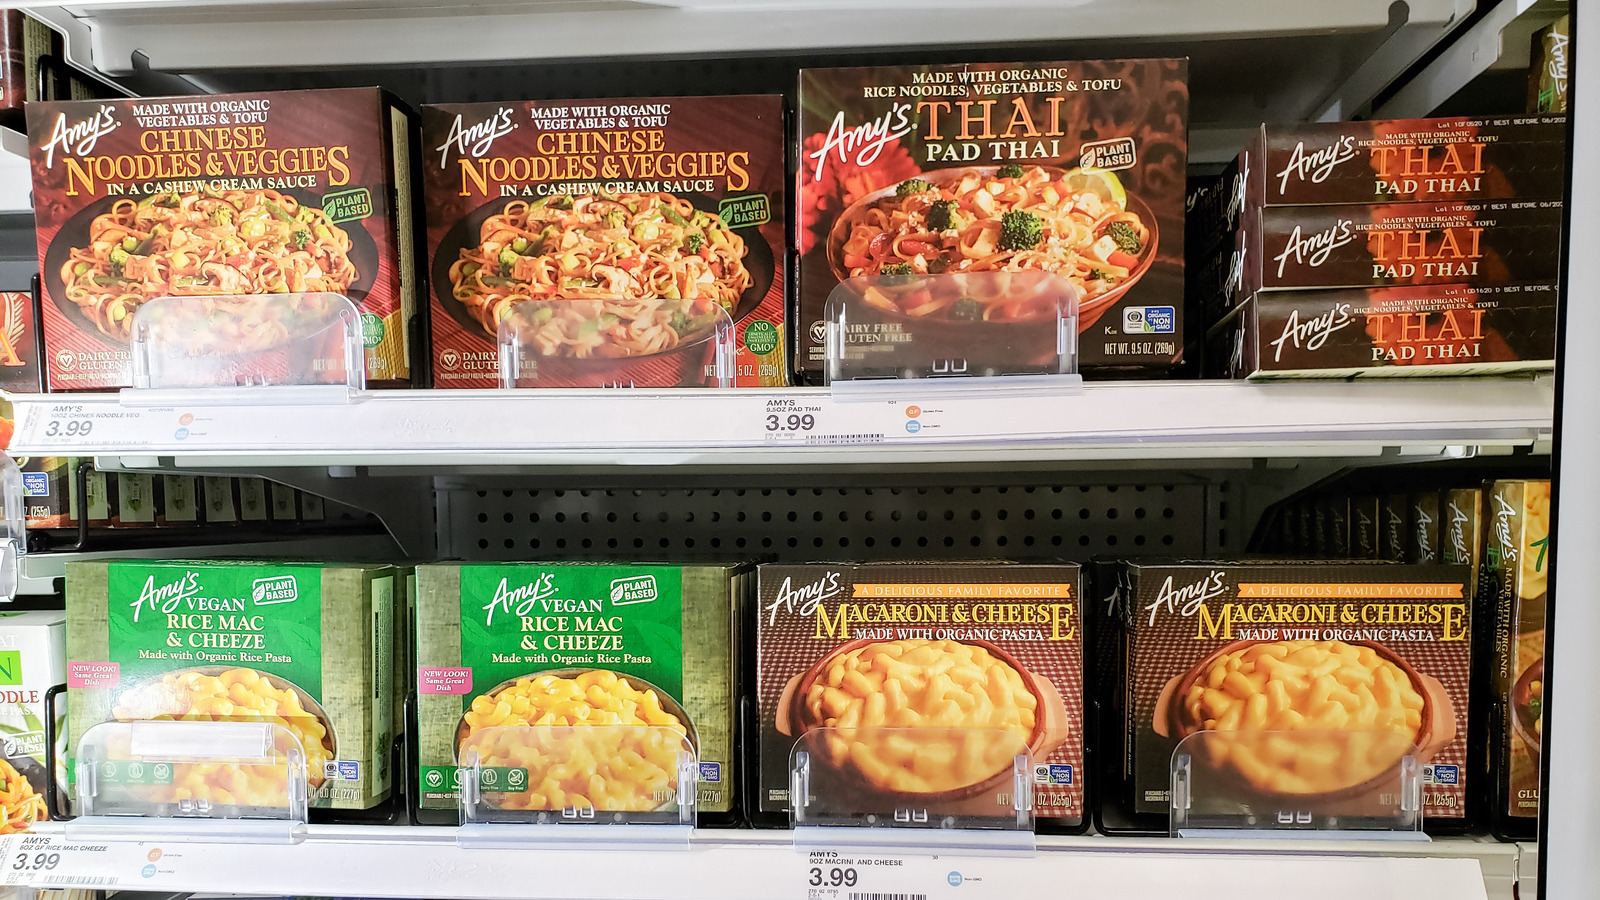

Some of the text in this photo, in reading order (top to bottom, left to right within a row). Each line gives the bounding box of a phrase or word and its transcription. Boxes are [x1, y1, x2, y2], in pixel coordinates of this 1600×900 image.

[913, 68, 1068, 84] MADE WITH ORGANIC
[864, 79, 1121, 98] RICE NOODLES, VEGETABLES & TOFU
[133, 100, 270, 116] MADE WITH ORGANIC
[531, 104, 671, 119] MADE WITH ORGANIC
[136, 111, 267, 127] VEGETABLES & TOFU
[534, 116, 668, 130] VEGETABLES & TOFU
[917, 97, 1065, 140] THAI
[140, 126, 267, 153] CHINESE
[537, 130, 665, 155] CHINESE
[926, 140, 1060, 162] PAD THAI
[1096, 142, 1130, 156] PLANT
[1097, 154, 1132, 168] BASED
[1371, 144, 1487, 177] THAI
[63, 146, 351, 196] NOODLES & VEGGIES
[458, 151, 750, 197] NOODLES & VEGGIES
[107, 175, 317, 195] IN A CASHEW CREAM SAUCE
[500, 179, 714, 197] IN A CASHEW CREAM SAUCE
[1375, 178, 1481, 194] PAD THAI
[337, 193, 366, 206] PLANT
[734, 199, 764, 212] PLANT
[337, 204, 369, 217] BASED
[734, 210, 766, 223] BASED
[1368, 228, 1484, 261] THAI
[1372, 262, 1478, 278] PAD THAI
[754, 323, 769, 332] NO
[1366, 310, 1486, 344] THAI
[1105, 342, 1117, 355] NET
[1118, 342, 1130, 355] WT.
[1131, 342, 1142, 354] 9.5
[1154, 341, 1175, 355] (269g)
[1371, 344, 1481, 360] PAD THAI
[45, 421, 93, 436] 3.99
[766, 414, 814, 430] 3.99
[266, 580, 293, 591] PLANT
[624, 580, 652, 591] PLANT
[625, 588, 654, 599] BASED
[862, 586, 1060, 596] A DELICIOUS FAMILY FAVORITE
[267, 589, 294, 599] BASED
[186, 599, 245, 611] VEGAN
[541, 599, 603, 613] VEGAN
[167, 614, 265, 630] RICE MAC
[520, 617, 623, 632] RICE MAC
[813, 603, 1075, 641] MACARONI & CHEESE
[1194, 603, 1466, 641] MACARONI & CHEESE
[1499, 566, 1513, 678] MADE WITH ORGANIC
[166, 633, 266, 650] & CHEEZE
[520, 635, 624, 650] & CHEEZE
[855, 628, 1044, 641] MADE WITH ORGANIC PASTA
[1239, 629, 1435, 641] MADE WITH ORGANIC PASTA
[492, 653, 652, 665] Made with Organic Rice Pasta
[17, 735, 43, 745] PLANT
[18, 743, 44, 753] BASED
[12, 853, 60, 870] 3.99
[809, 867, 858, 886] 3.99
